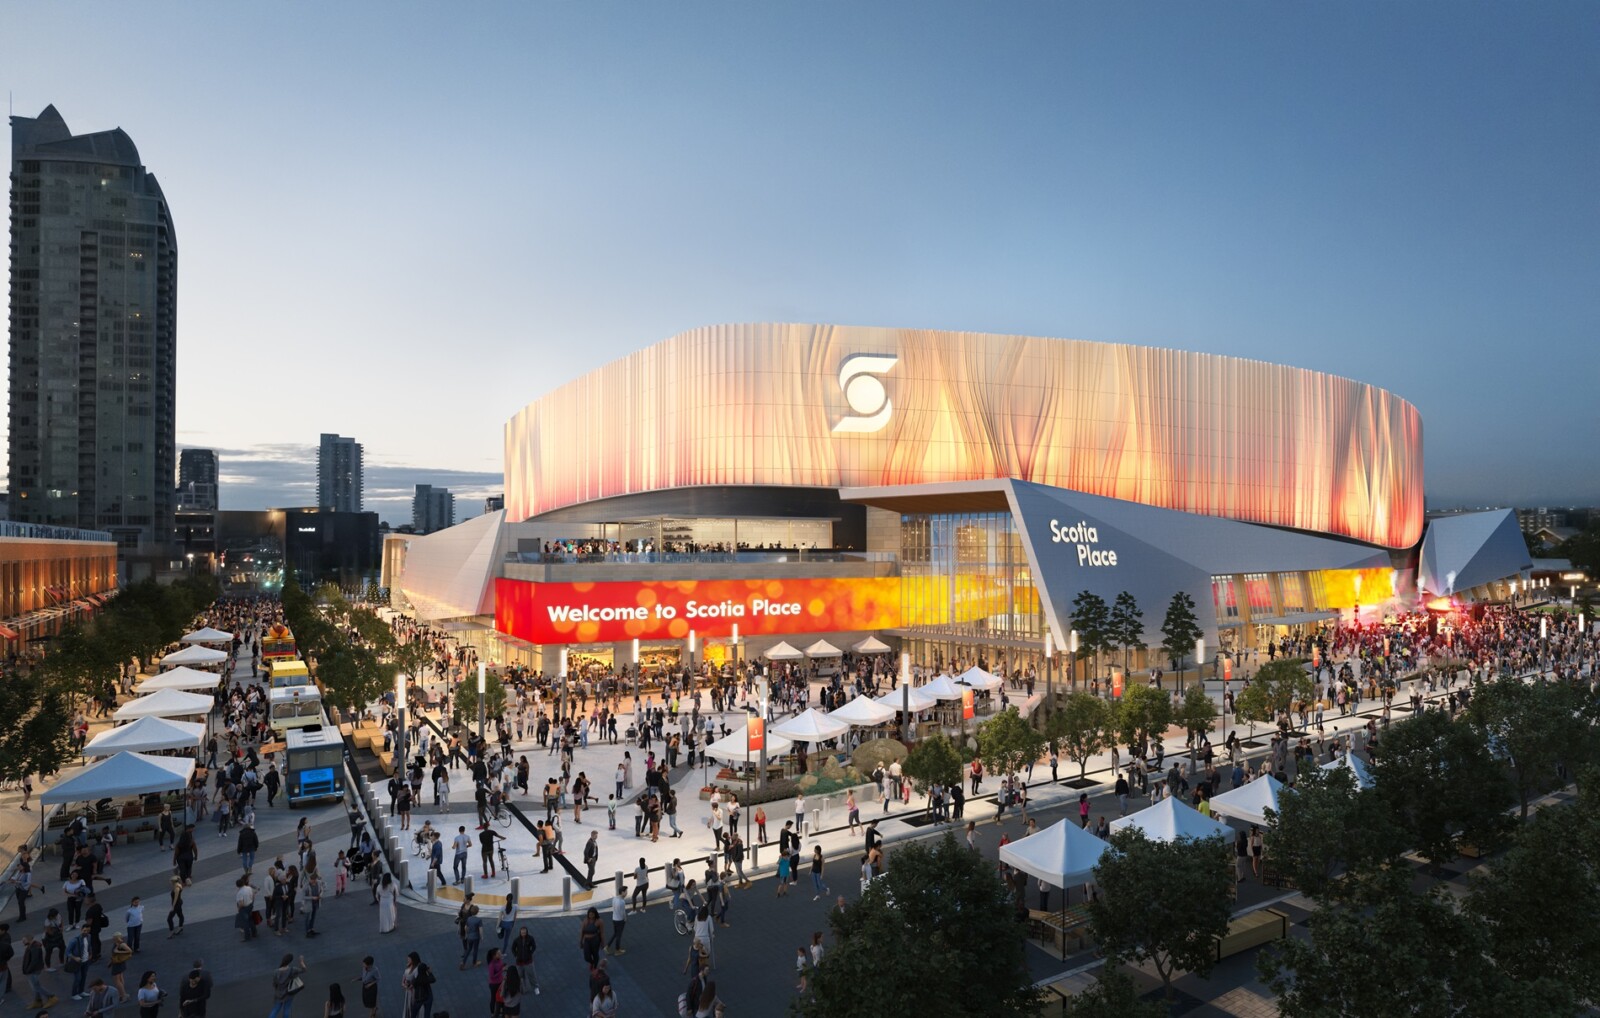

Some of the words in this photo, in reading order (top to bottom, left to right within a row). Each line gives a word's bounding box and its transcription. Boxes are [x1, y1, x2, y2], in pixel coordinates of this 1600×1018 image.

[1050, 519, 1098, 543] Scotia
[1077, 544, 1117, 566] Place
[547, 604, 648, 622] Welcome
[655, 603, 677, 619] to
[686, 600, 745, 618] Scotia
[752, 599, 802, 616] Place
